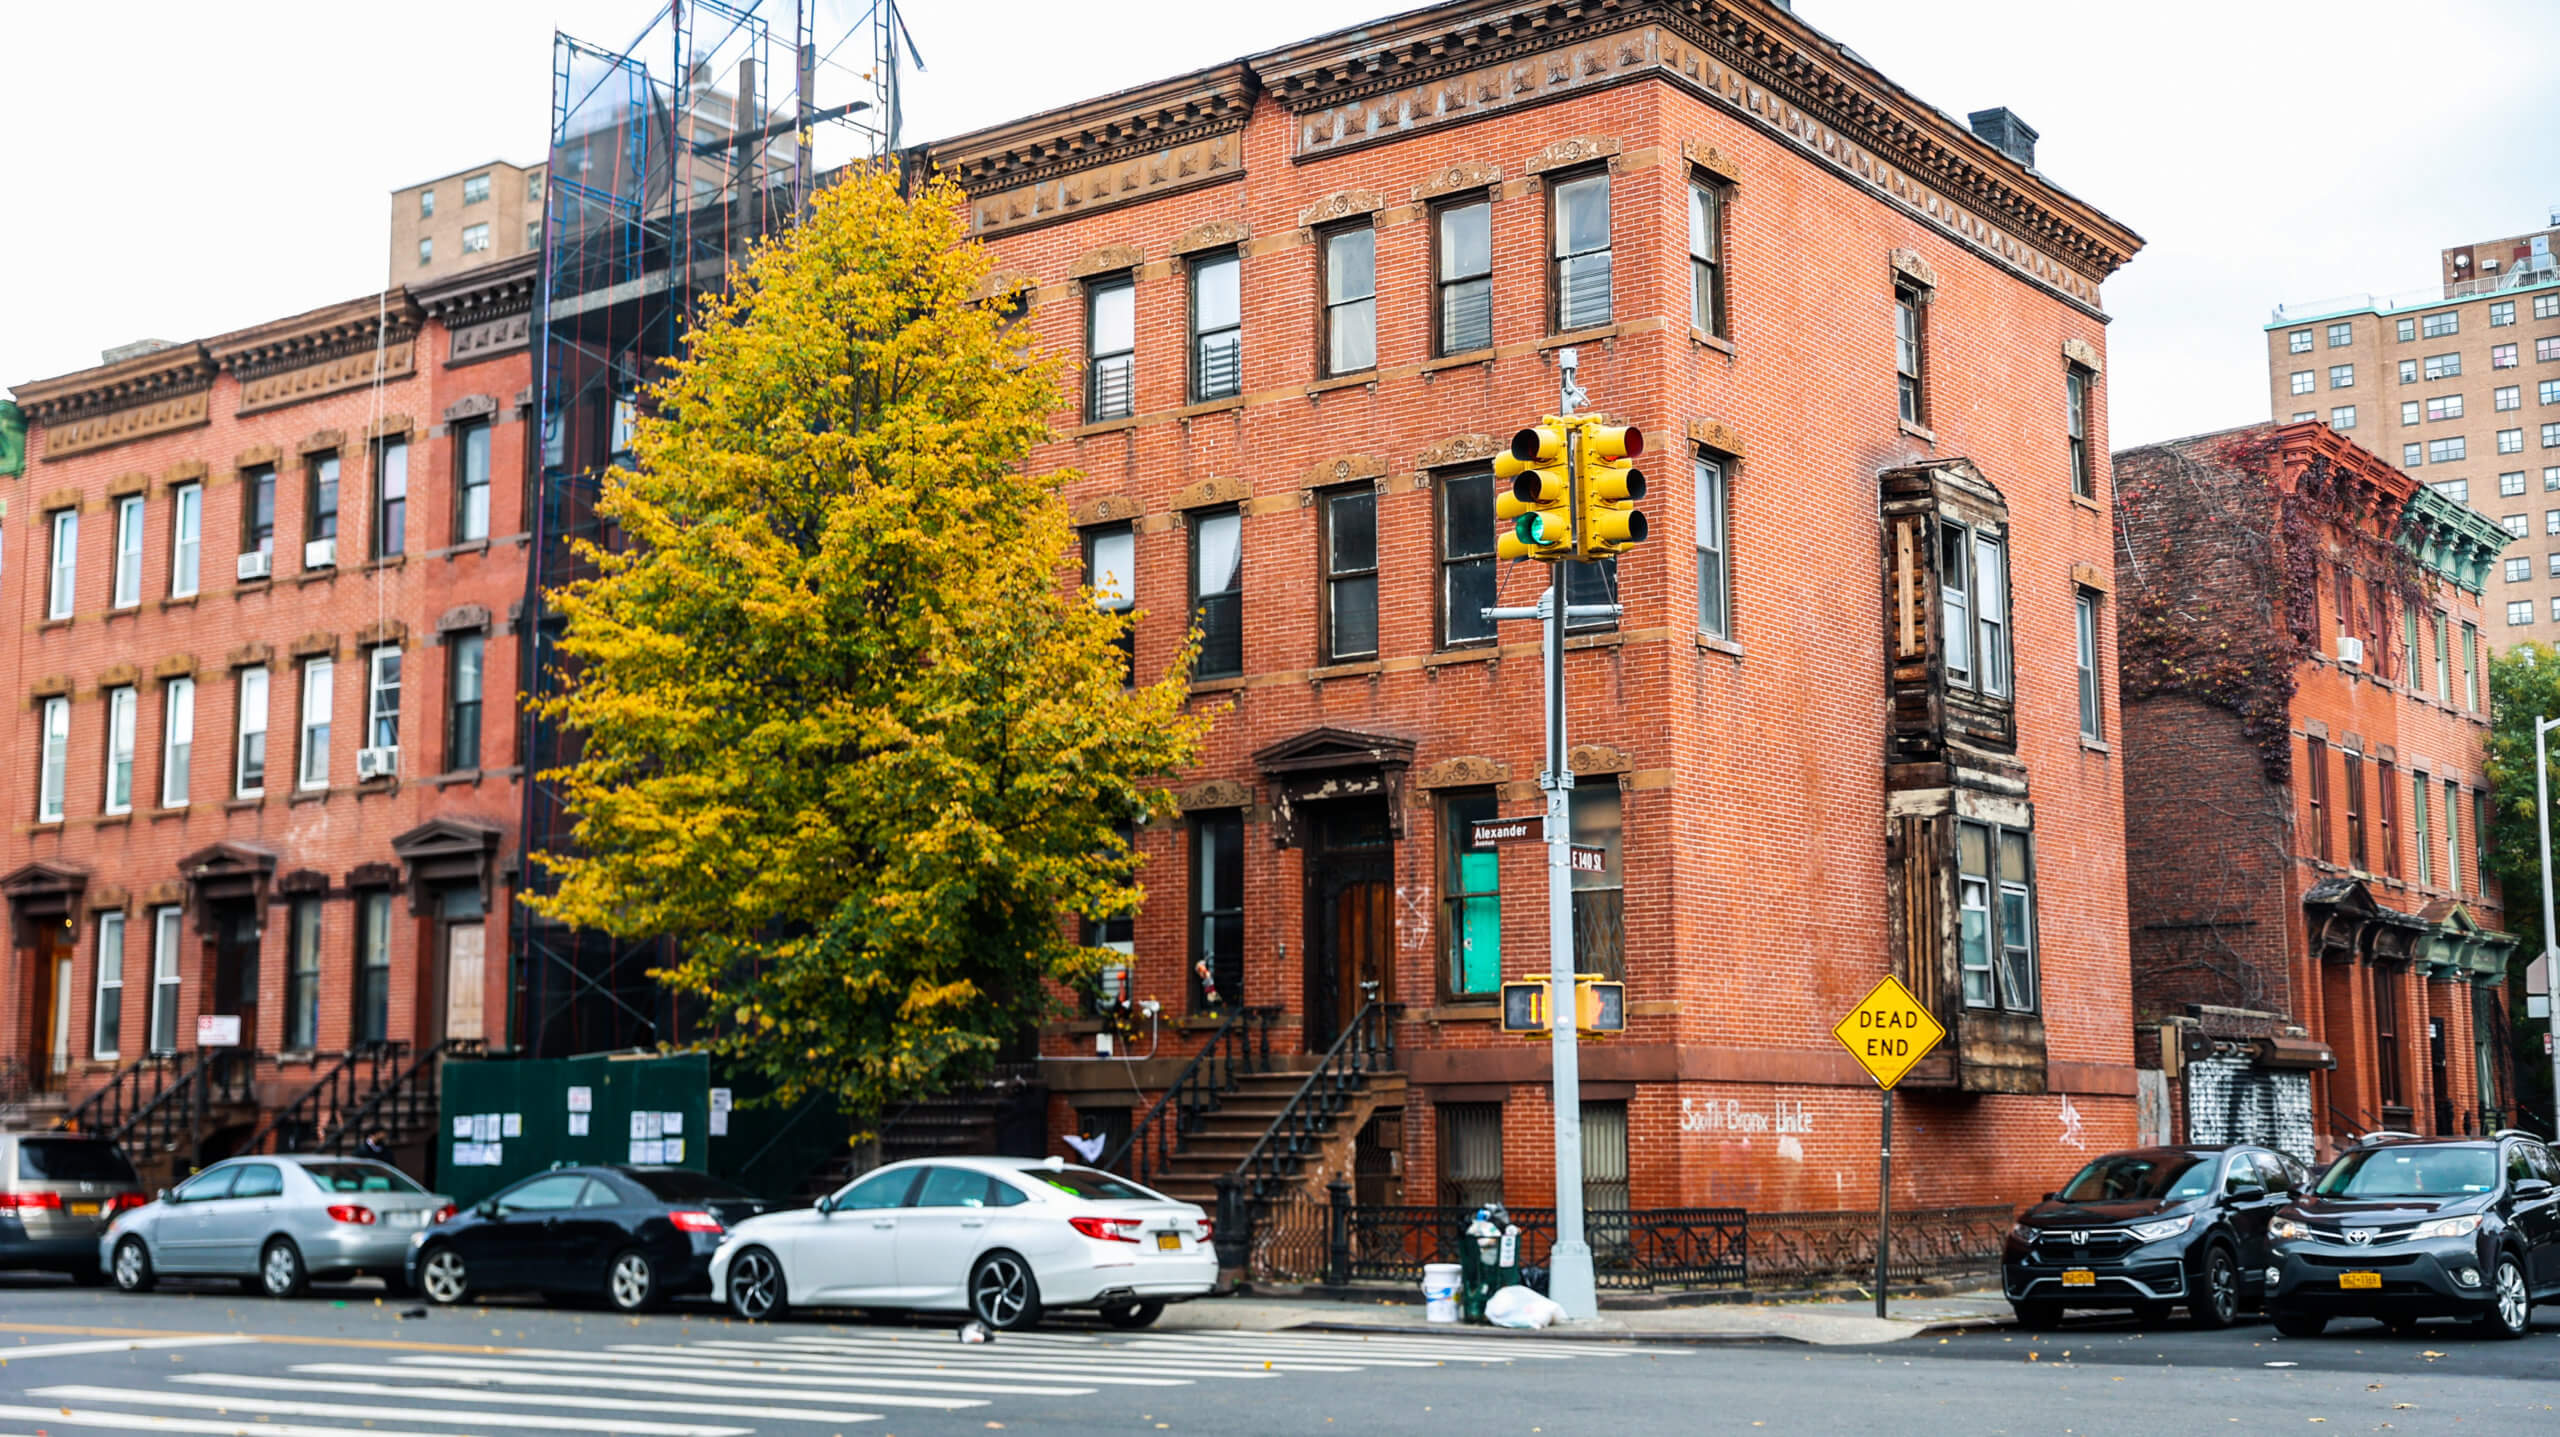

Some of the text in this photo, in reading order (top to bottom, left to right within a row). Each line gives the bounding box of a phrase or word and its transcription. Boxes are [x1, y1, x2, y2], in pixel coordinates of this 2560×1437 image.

[1475, 824, 1527, 840] Alexander
[1572, 850, 1602, 871] E 140 St
[1860, 1011, 1918, 1028] DEAD
[1867, 1038, 1909, 1056] END
[1727, 1099, 1769, 1132] Bronx
[1775, 1101, 1814, 1132] Unite
